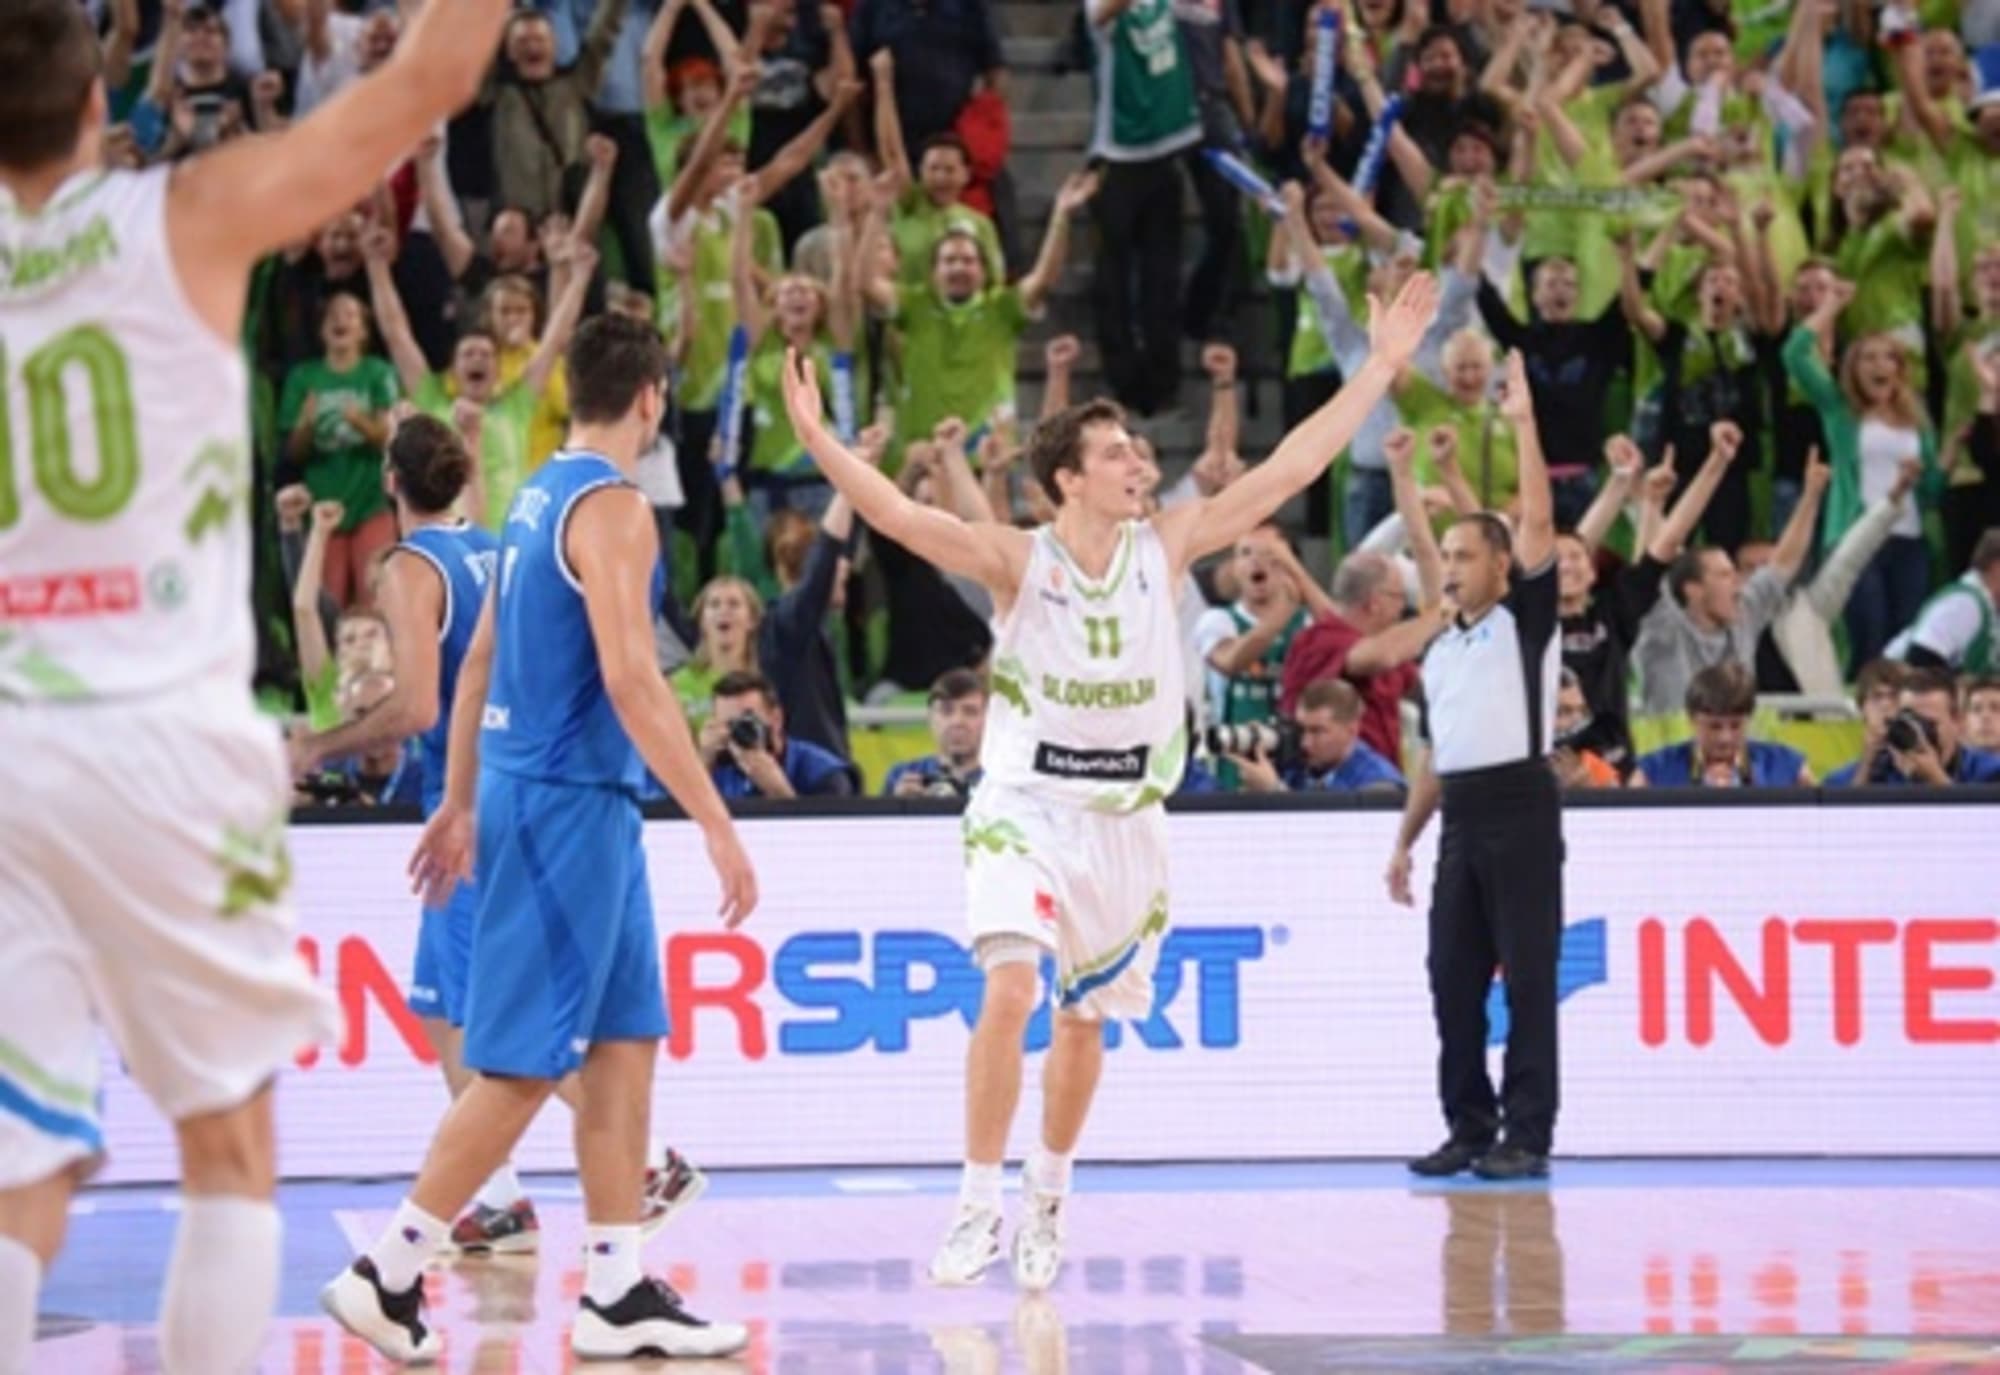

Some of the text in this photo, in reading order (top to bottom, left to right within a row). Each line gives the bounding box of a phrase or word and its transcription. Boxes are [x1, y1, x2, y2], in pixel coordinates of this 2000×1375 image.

[1084, 616, 1121, 659] 11
[1041, 673, 1155, 708] SLOVENIJA
[1638, 916, 2000, 1047] INTE
